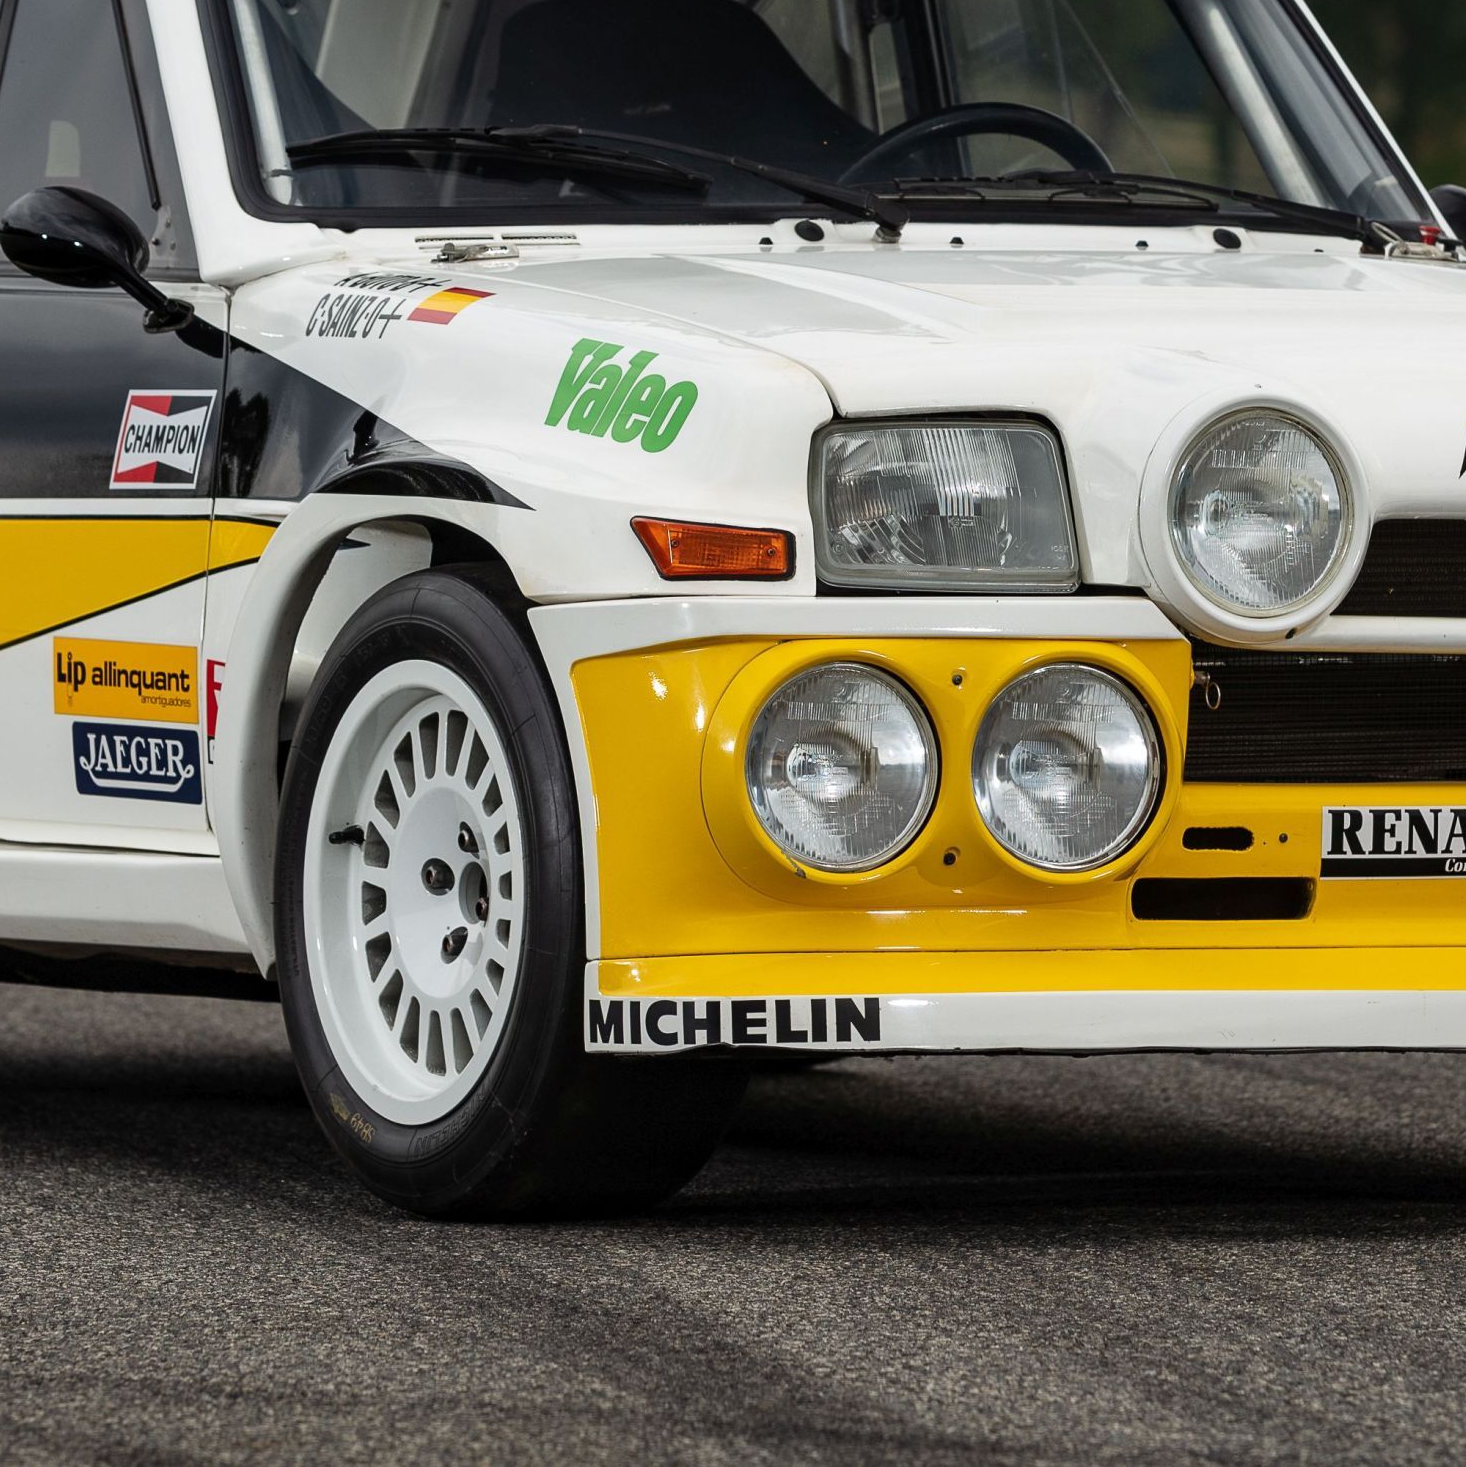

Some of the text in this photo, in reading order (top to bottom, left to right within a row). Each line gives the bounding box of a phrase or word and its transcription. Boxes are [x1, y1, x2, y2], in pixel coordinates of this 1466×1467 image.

[544, 338, 699, 453] Valeo
[124, 423, 201, 455] CHAMPION
[56, 651, 87, 692] Lip
[91, 661, 190, 696] allinquant
[79, 732, 195, 779] JAEGER
[589, 997, 881, 1046] MICHELIN
